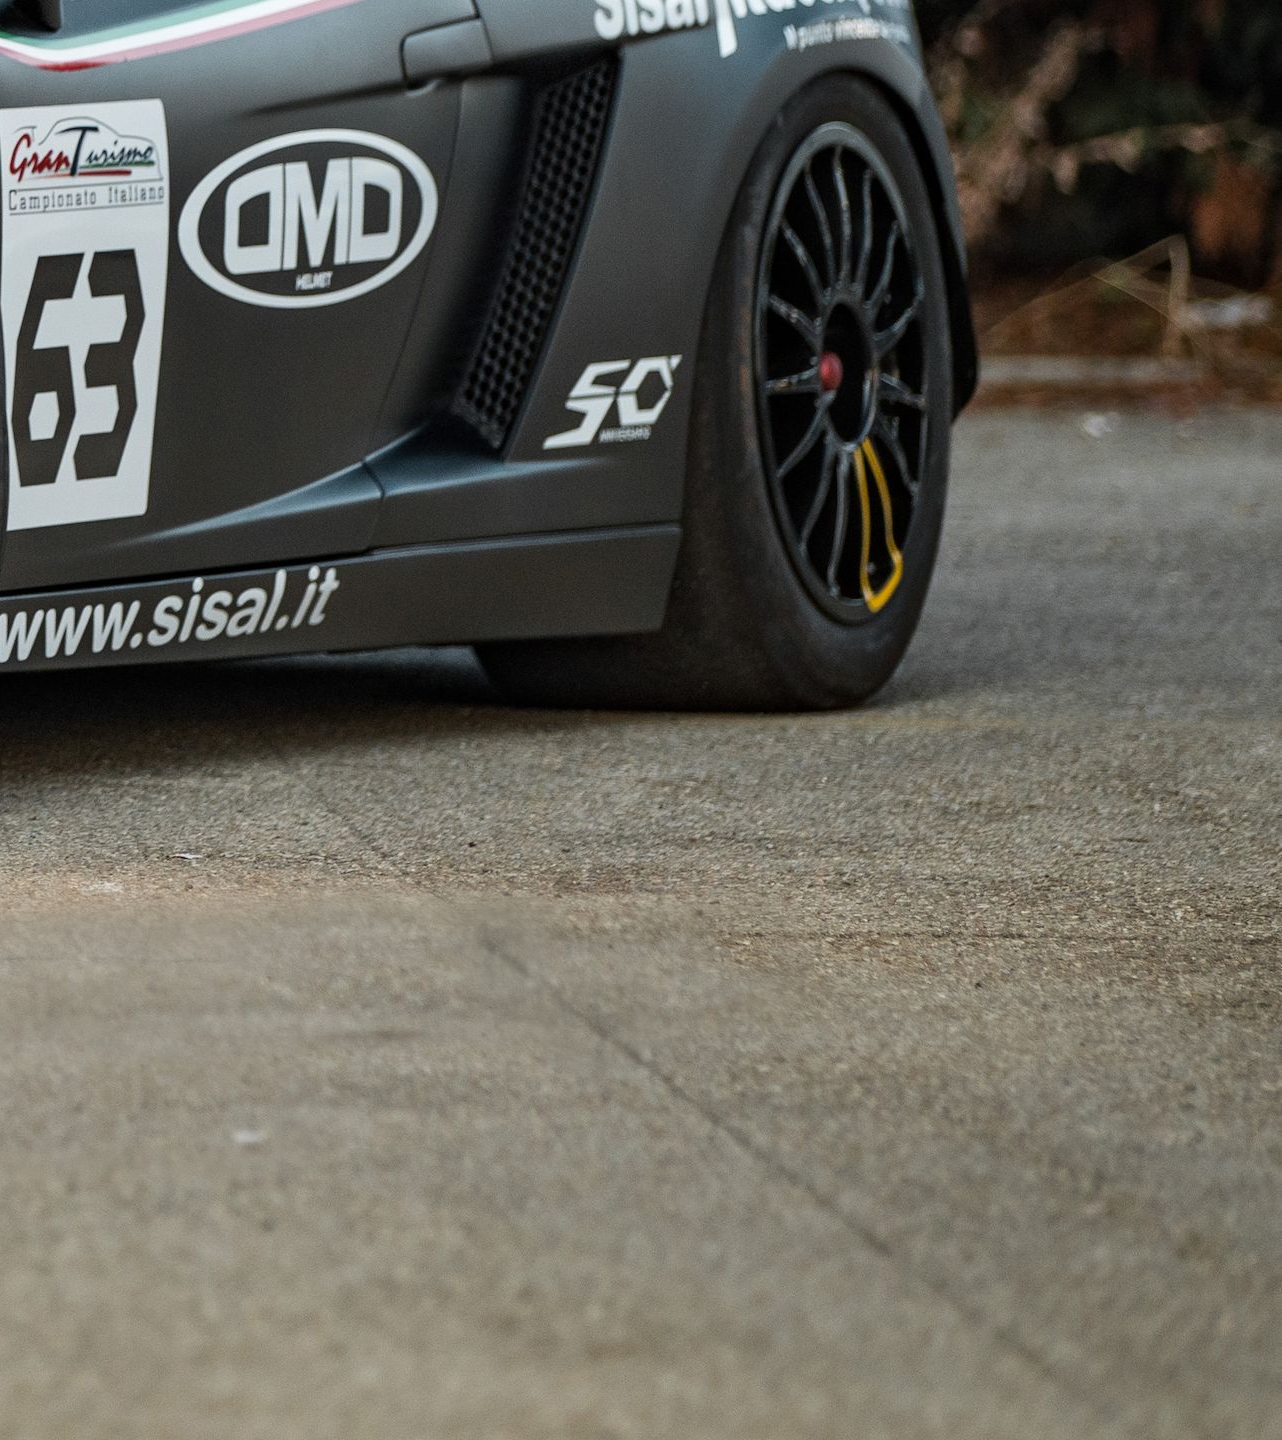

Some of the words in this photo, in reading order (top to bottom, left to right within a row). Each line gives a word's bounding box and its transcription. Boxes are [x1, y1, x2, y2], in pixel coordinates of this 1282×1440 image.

[8, 189, 97, 213] Campionato
[108, 185, 165, 204] Italiano
[12, 248, 146, 488] 63
